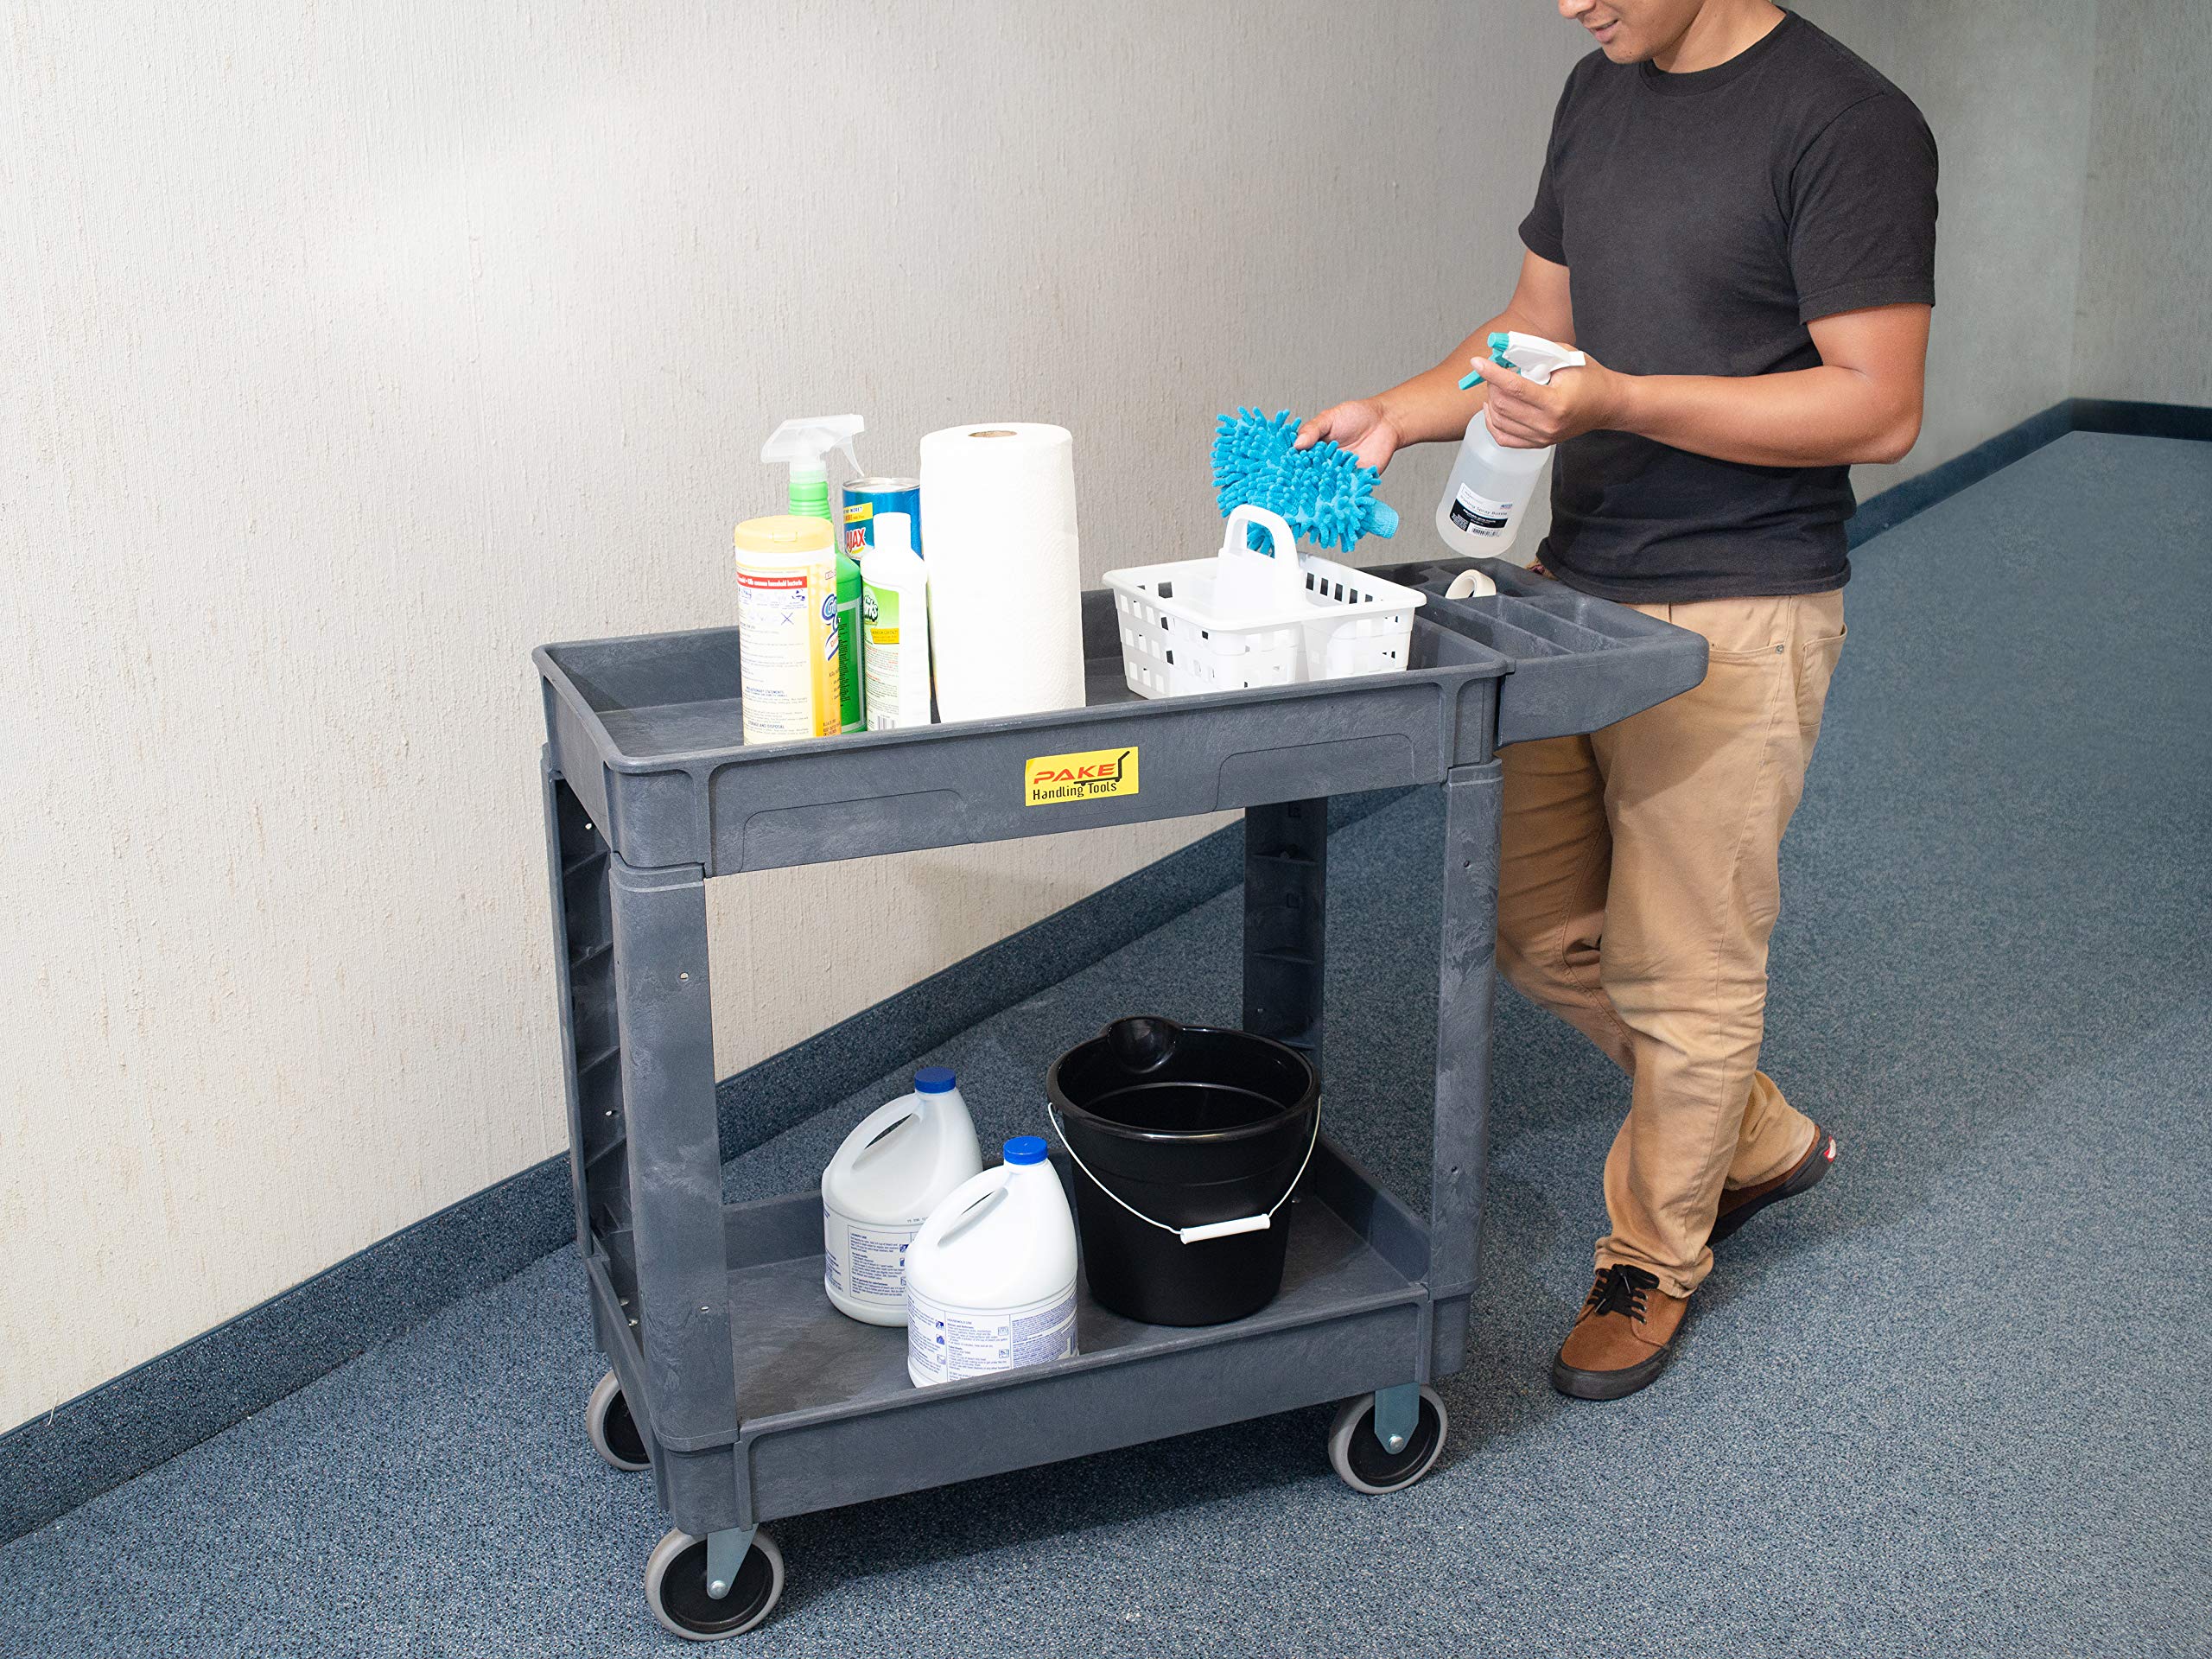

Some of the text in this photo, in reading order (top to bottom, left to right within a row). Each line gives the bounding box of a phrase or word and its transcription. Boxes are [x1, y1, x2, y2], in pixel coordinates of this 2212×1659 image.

[846, 528, 866, 553] AJAX
[1033, 763, 1116, 785] PAKE
[1033, 782, 1117, 800] Handling Tools
